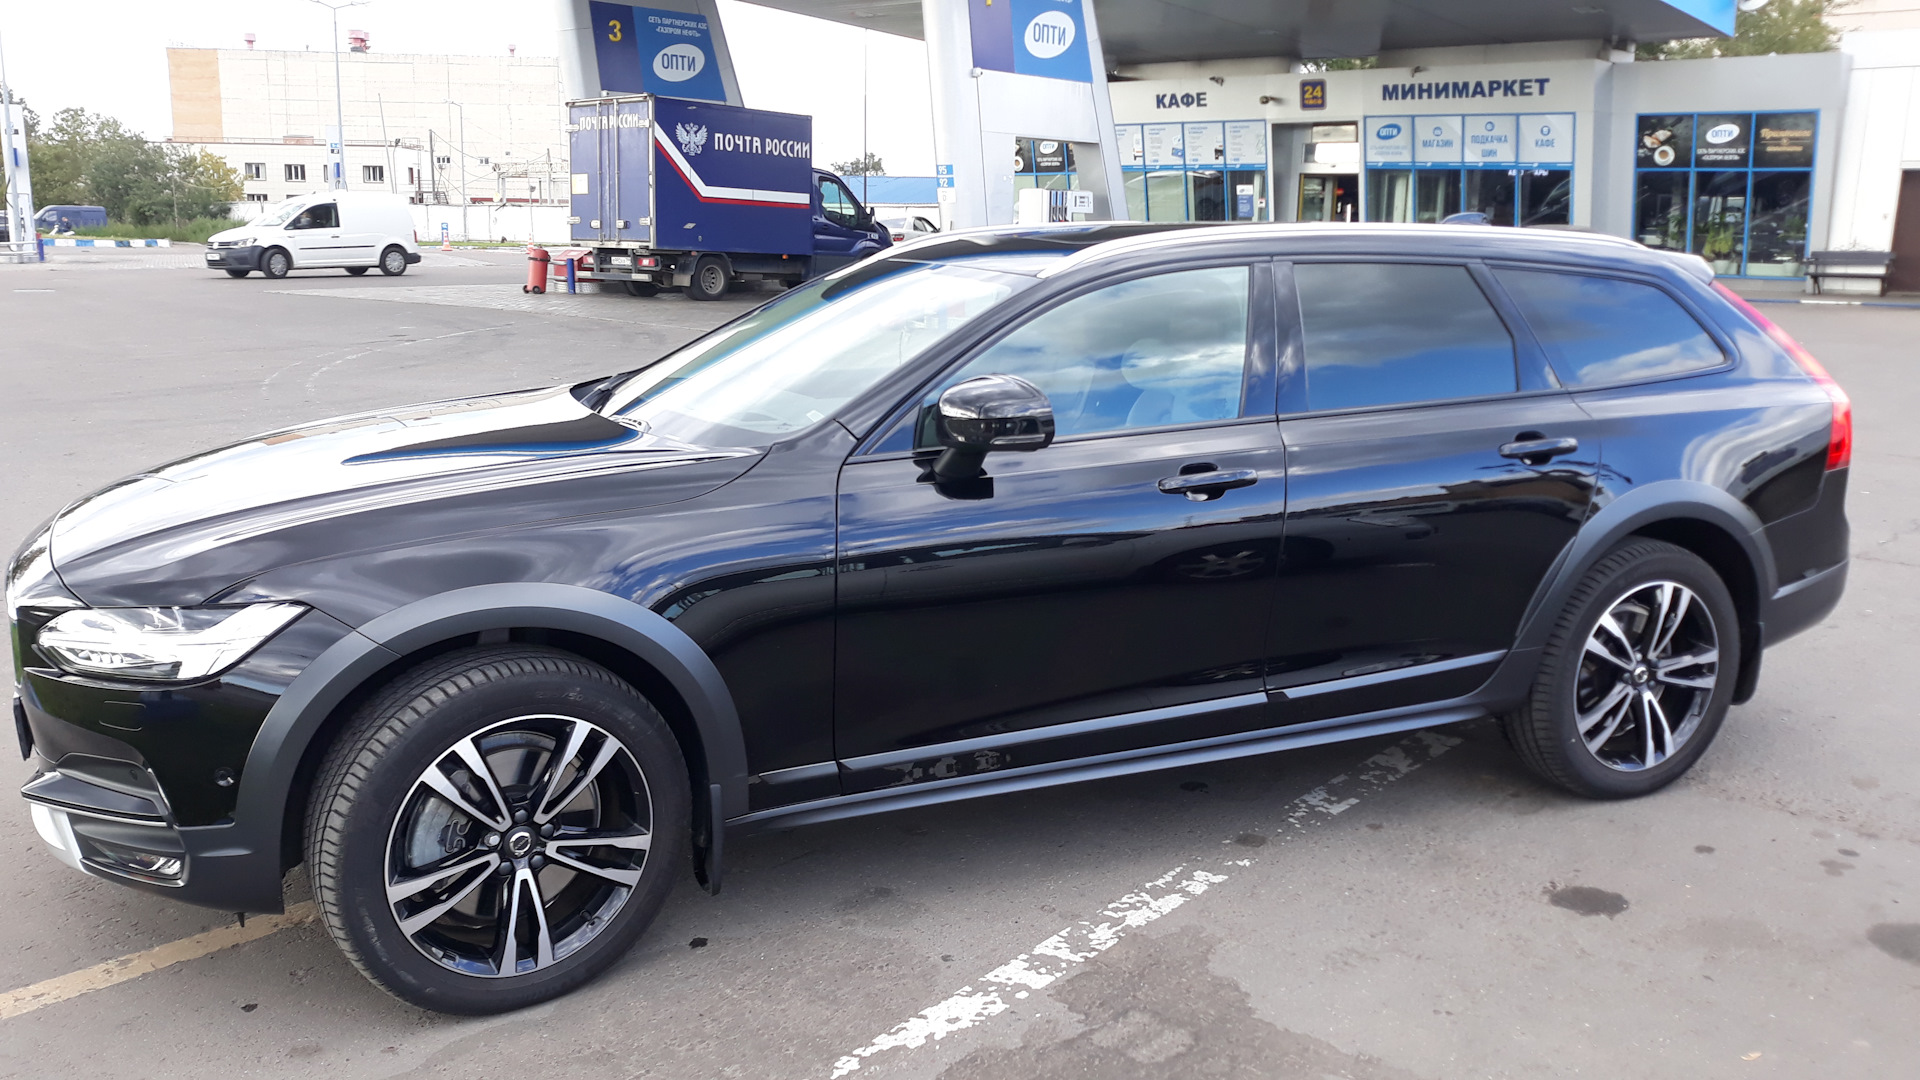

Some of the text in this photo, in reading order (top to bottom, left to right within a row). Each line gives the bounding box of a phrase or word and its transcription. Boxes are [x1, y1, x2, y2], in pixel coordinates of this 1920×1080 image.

[648, 15, 662, 25] СЕТЬ
[608, 19, 622, 42] 3
[1032, 22, 1067, 47] ОПТИ
[661, 52, 696, 72] ОПТИ
[1303, 85, 1323, 99] 24
[1382, 77, 1551, 101] МИНИМАРКЕТ
[1155, 91, 1208, 109] КАФЕ
[1379, 127, 1398, 137] ОПТИ
[1711, 129, 1734, 138] ОПТИ
[1422, 139, 1454, 148] МАГАЗИН
[1470, 134, 1509, 144] ПОДКАЧКА
[1535, 138, 1556, 147] КАФЕ
[714, 132, 811, 159] ПОЧТА РОССИИ
[1481, 148, 1498, 157] ШИН
[938, 165, 948, 175] 95
[938, 178, 949, 188] 92
